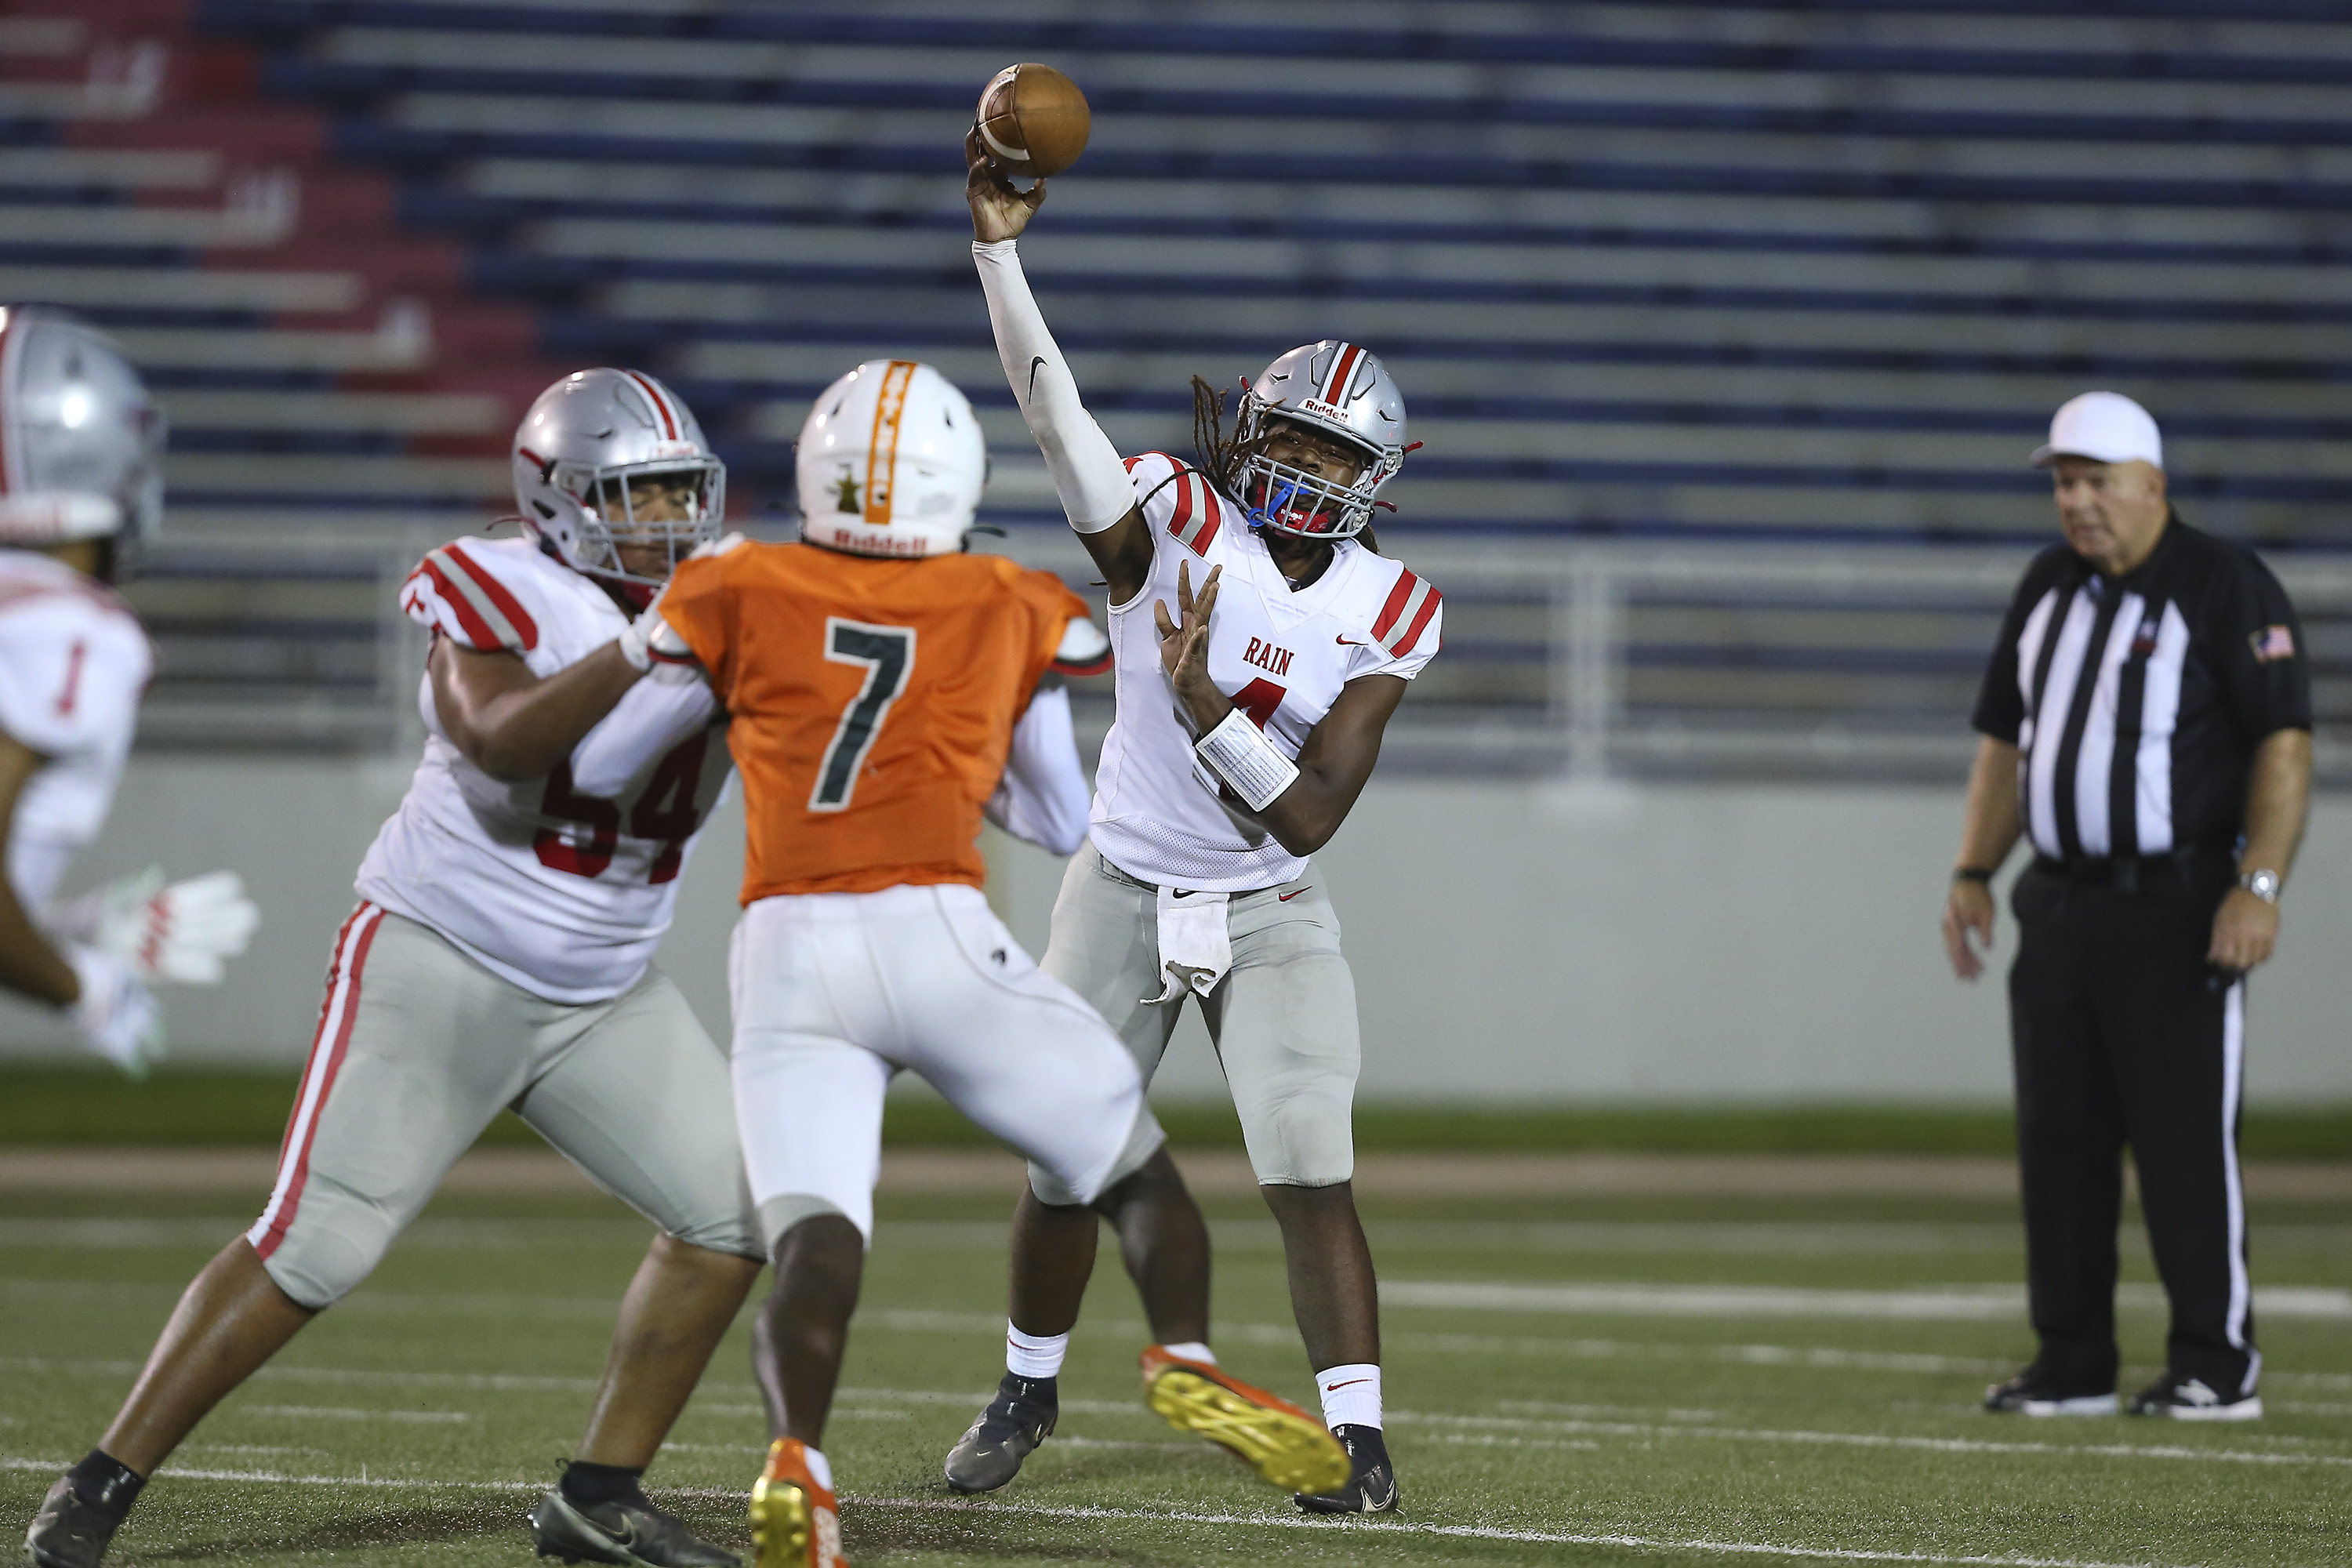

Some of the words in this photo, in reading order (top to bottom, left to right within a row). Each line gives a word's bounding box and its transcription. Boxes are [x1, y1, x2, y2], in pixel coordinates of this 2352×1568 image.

[1305, 400, 1348, 423] Riddell
[1280, 508, 1304, 521] Rddell
[56, 641, 85, 717] 1
[1243, 636, 1294, 677] RAIN
[807, 615, 917, 813] 7
[533, 733, 709, 885] 54
